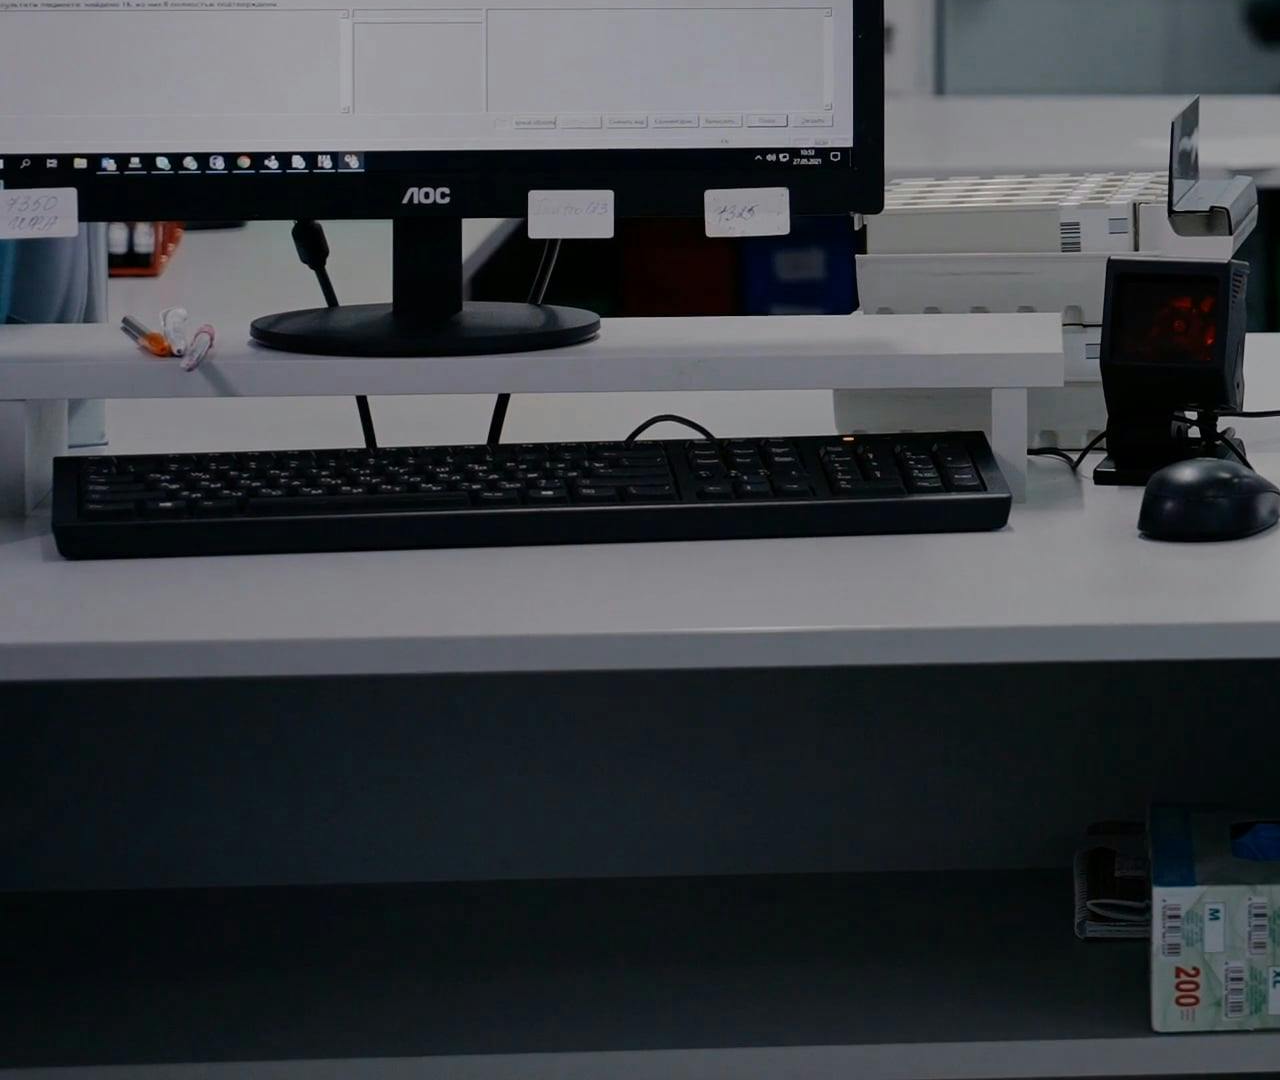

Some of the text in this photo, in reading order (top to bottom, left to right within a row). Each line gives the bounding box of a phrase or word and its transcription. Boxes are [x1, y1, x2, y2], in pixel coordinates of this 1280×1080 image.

[401, 186, 451, 204] AOC
[1208, 908, 1221, 921] M
[1174, 965, 1201, 1007] 200
